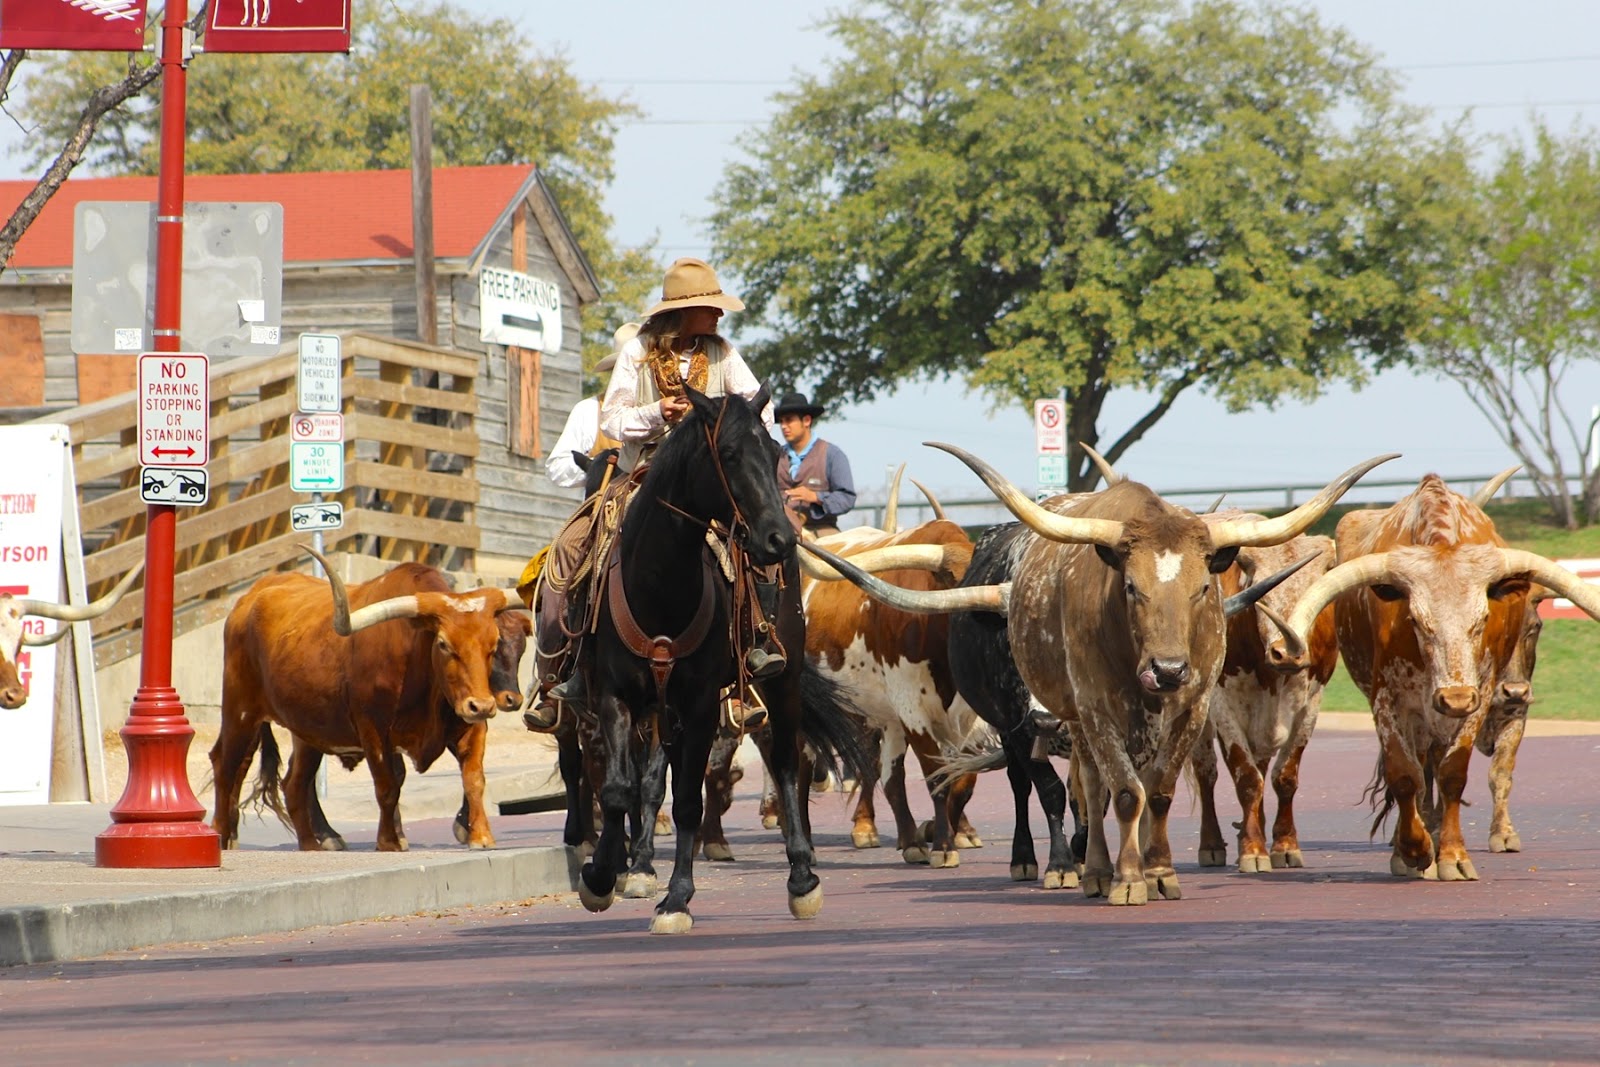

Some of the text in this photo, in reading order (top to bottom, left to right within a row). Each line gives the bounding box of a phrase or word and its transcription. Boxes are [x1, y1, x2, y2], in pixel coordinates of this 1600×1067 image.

[482, 269, 558, 311] FREE PARKING
[315, 345, 324, 354] NO
[302, 356, 337, 367] MOTORIZED
[161, 362, 186, 379] NO
[304, 369, 335, 379] VEHICLES
[149, 383, 199, 396] PARKING
[315, 381, 324, 390] ON
[304, 393, 334, 403] SIDEWALK
[146, 398, 202, 411] STOPPING
[166, 414, 182, 426] OR
[146, 429, 202, 441] STANDING
[318, 429, 335, 437] ZONE
[310, 447, 325, 457] 30
[0, 545, 48, 562] rson
